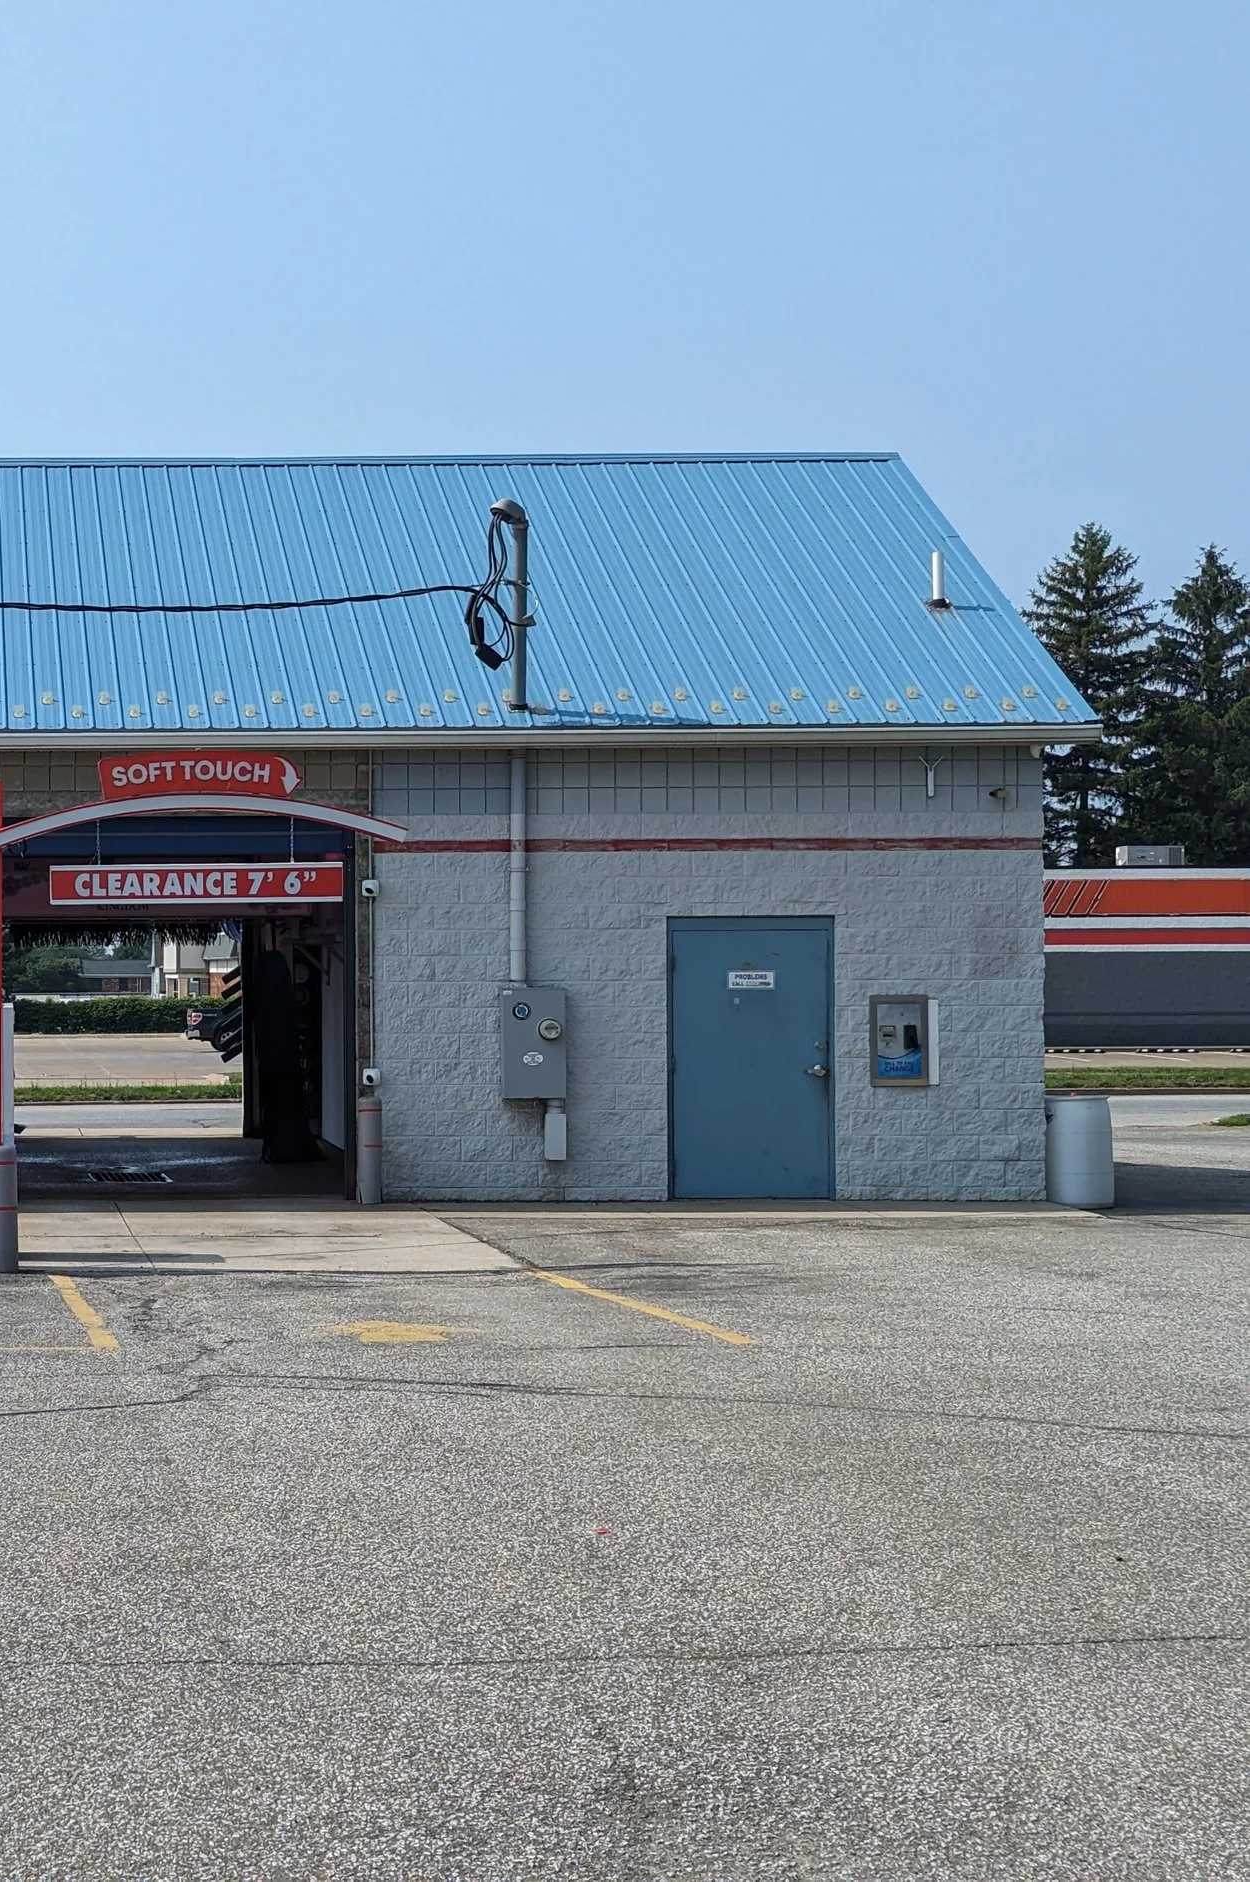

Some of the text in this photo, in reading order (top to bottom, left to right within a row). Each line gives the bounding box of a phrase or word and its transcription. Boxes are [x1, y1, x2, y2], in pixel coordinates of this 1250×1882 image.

[111, 760, 270, 787] SOFT TOUCH
[74, 872, 238, 897] CLEARANCE
